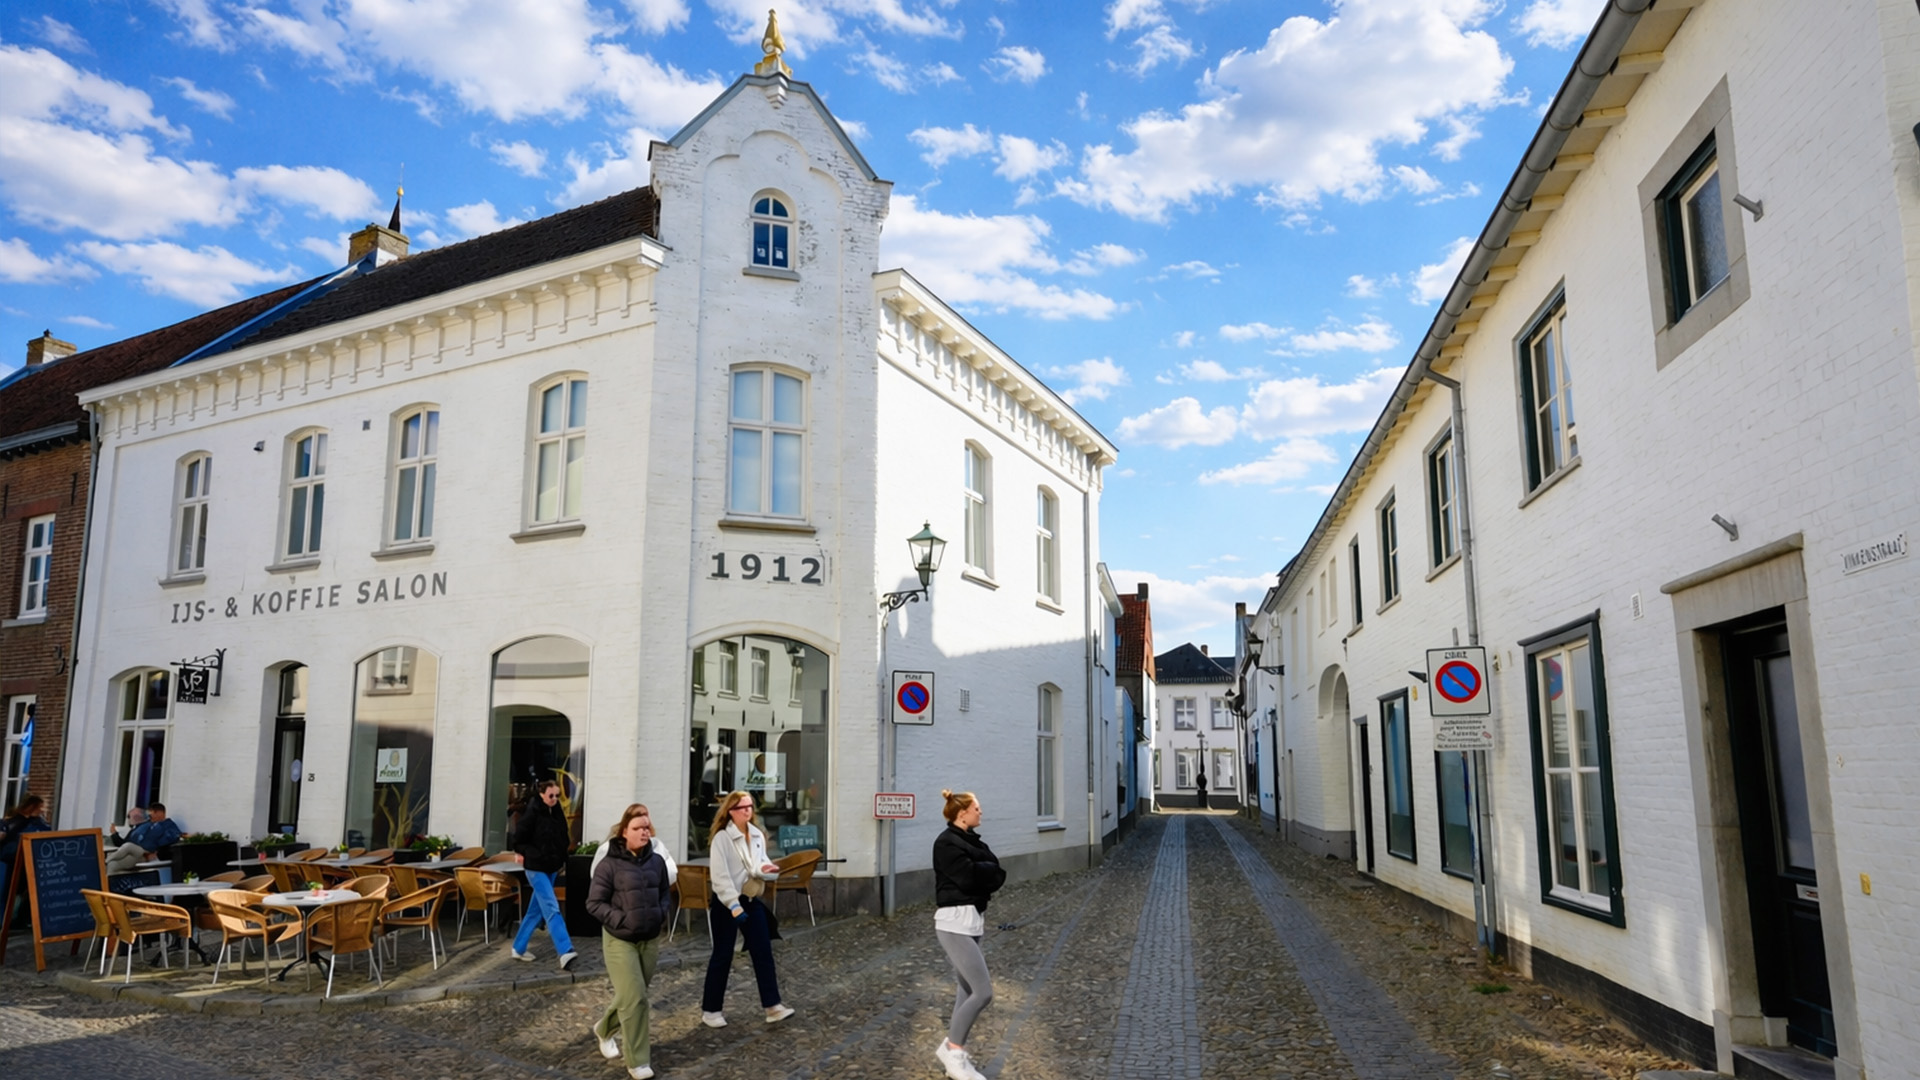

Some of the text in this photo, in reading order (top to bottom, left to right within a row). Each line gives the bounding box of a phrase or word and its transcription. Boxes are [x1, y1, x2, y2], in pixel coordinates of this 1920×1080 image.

[711, 552, 821, 584] 1912
[171, 571, 448, 623] IJS- & KOFFIE SALON
